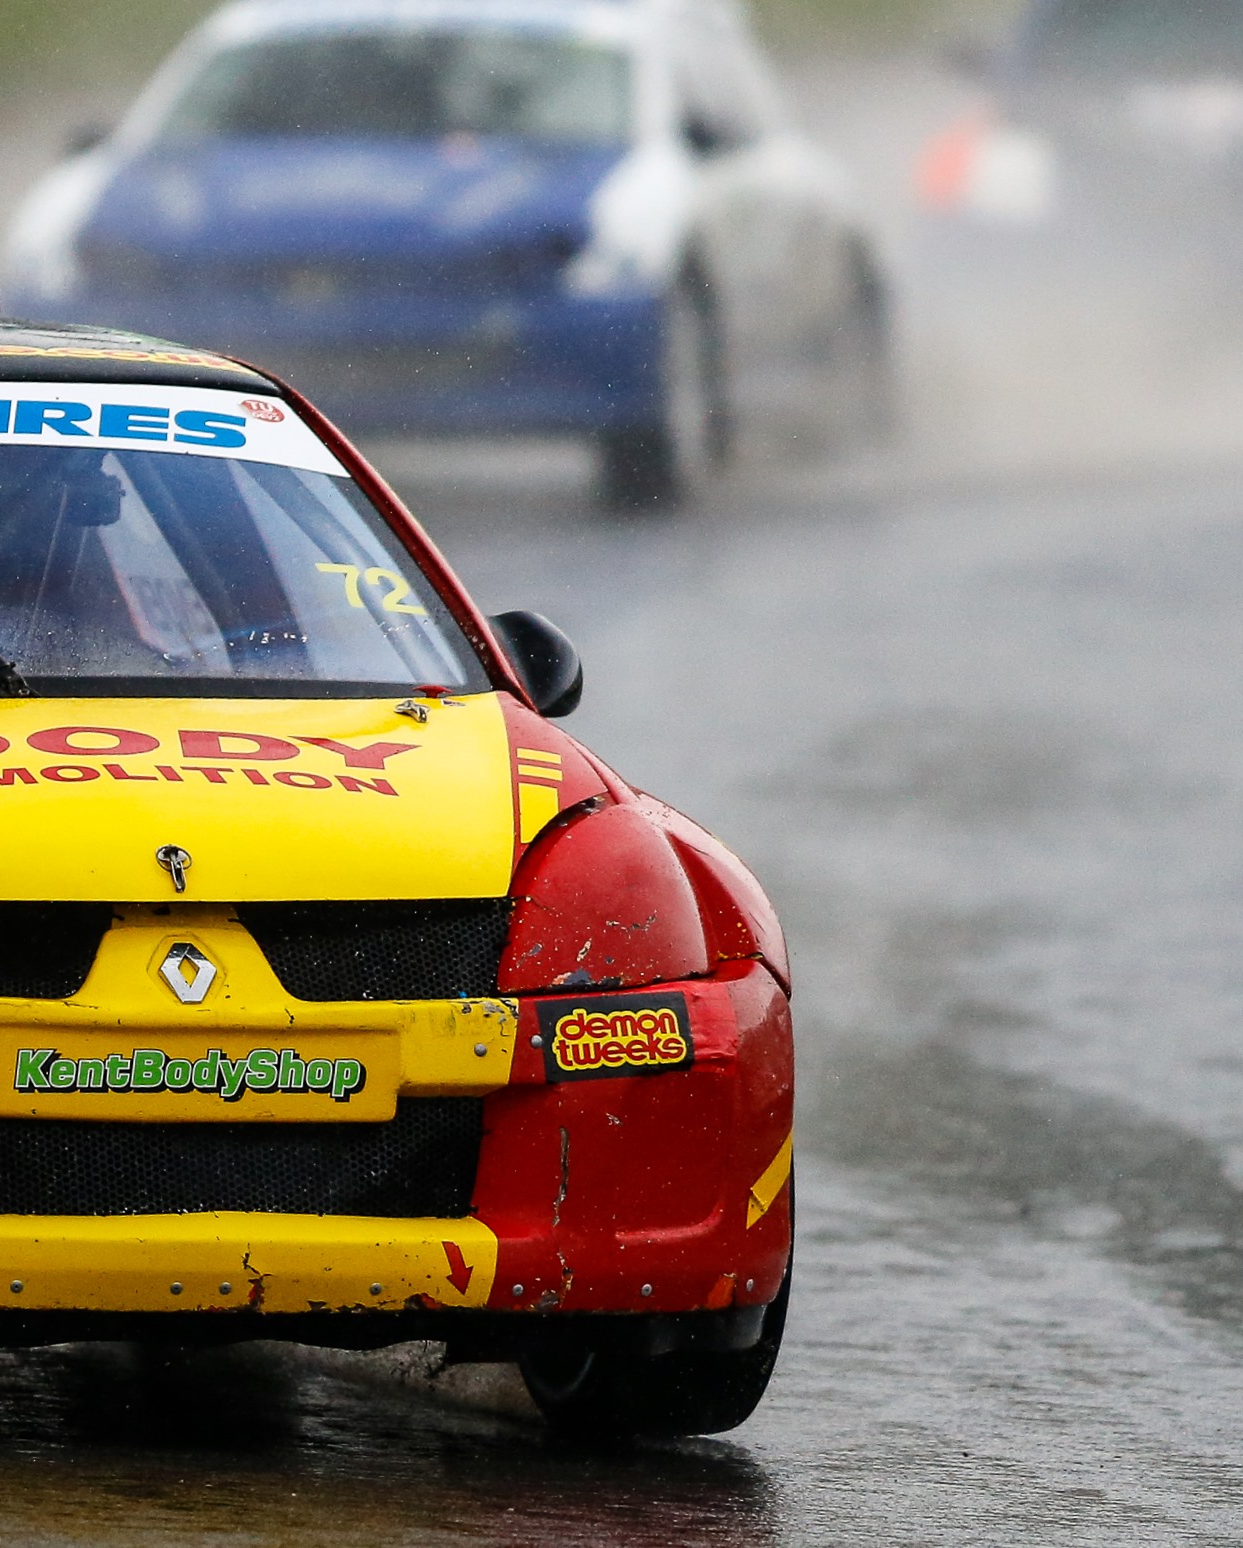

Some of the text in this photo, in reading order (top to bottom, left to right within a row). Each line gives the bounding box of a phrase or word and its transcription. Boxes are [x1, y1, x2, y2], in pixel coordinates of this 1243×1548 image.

[315, 563, 427, 616] 72
[559, 1012, 677, 1041] demon
[555, 1037, 685, 1067] tweeks
[14, 1049, 364, 1100] KentBodyShop
